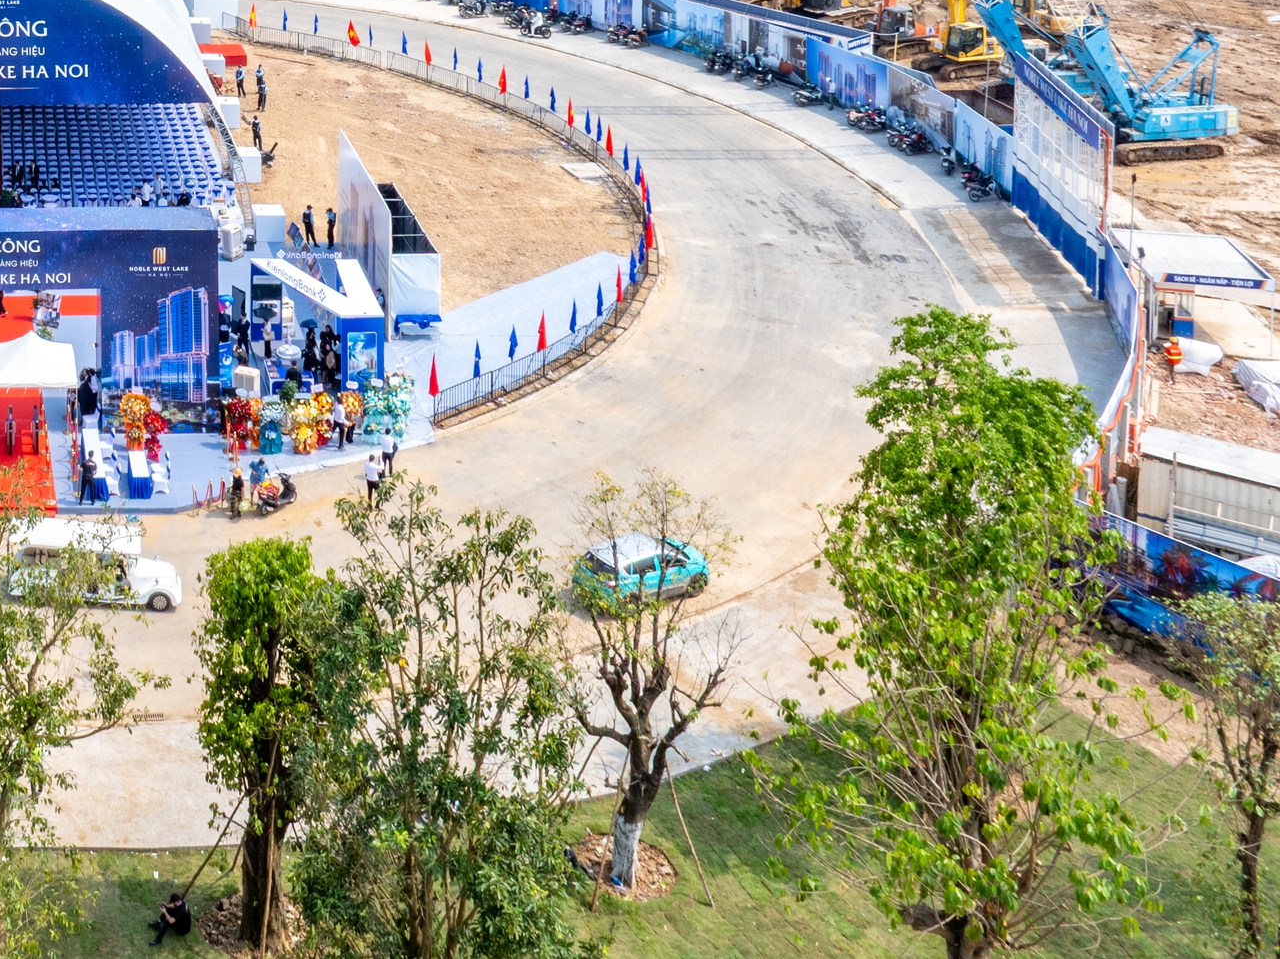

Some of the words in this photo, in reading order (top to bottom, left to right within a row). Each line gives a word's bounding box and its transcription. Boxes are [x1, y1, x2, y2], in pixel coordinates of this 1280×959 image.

[21, 45, 46, 59] HIỆU
[22, 65, 49, 79] HA
[54, 64, 89, 78] NOI
[1023, 64, 1040, 90] NOBLE
[1040, 80, 1054, 103] WEST
[19, 259, 39, 269] HIỆU
[20, 273, 41, 284] HA
[45, 272, 71, 284] NOI
[266, 259, 318, 298] KienlongBank
